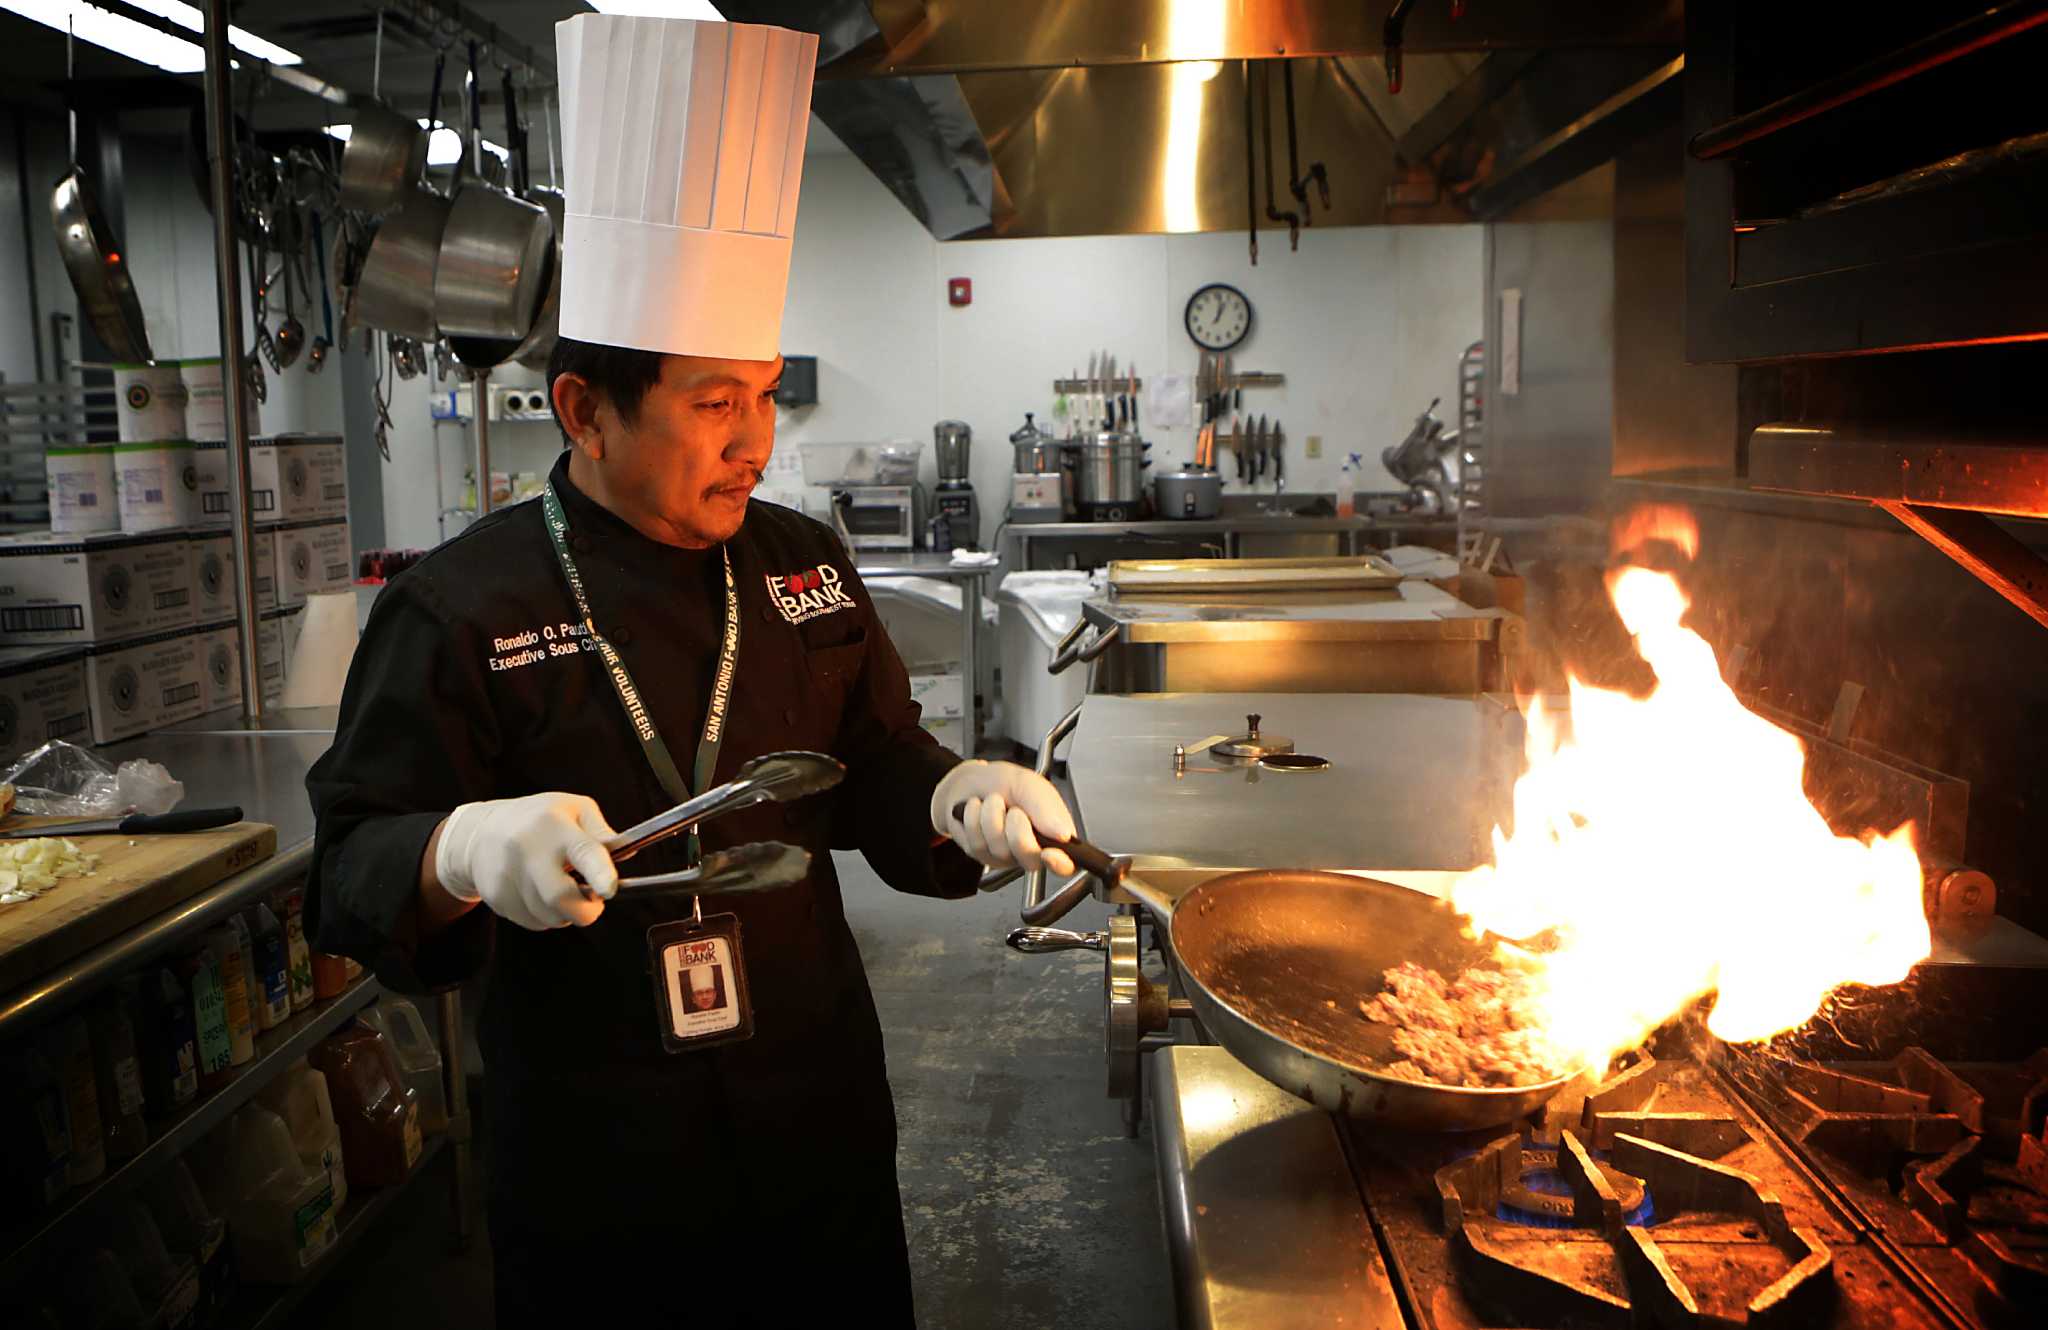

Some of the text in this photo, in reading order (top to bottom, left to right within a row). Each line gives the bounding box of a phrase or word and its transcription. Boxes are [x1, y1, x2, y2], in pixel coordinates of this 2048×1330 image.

[780, 581, 851, 618] BANK
[489, 649, 546, 671] Executive
[549, 642, 579, 657] Sous
[581, 638, 598, 651] Ch
[494, 630, 539, 653] Ronaldo
[543, 626, 557, 640] O.
[706, 717, 722, 743] SAN
[714, 661, 734, 716] ANTONIO
[727, 590, 738, 624] BANK
[612, 667, 655, 741] VOLUNTEERS
[685, 951, 717, 965] BANK
